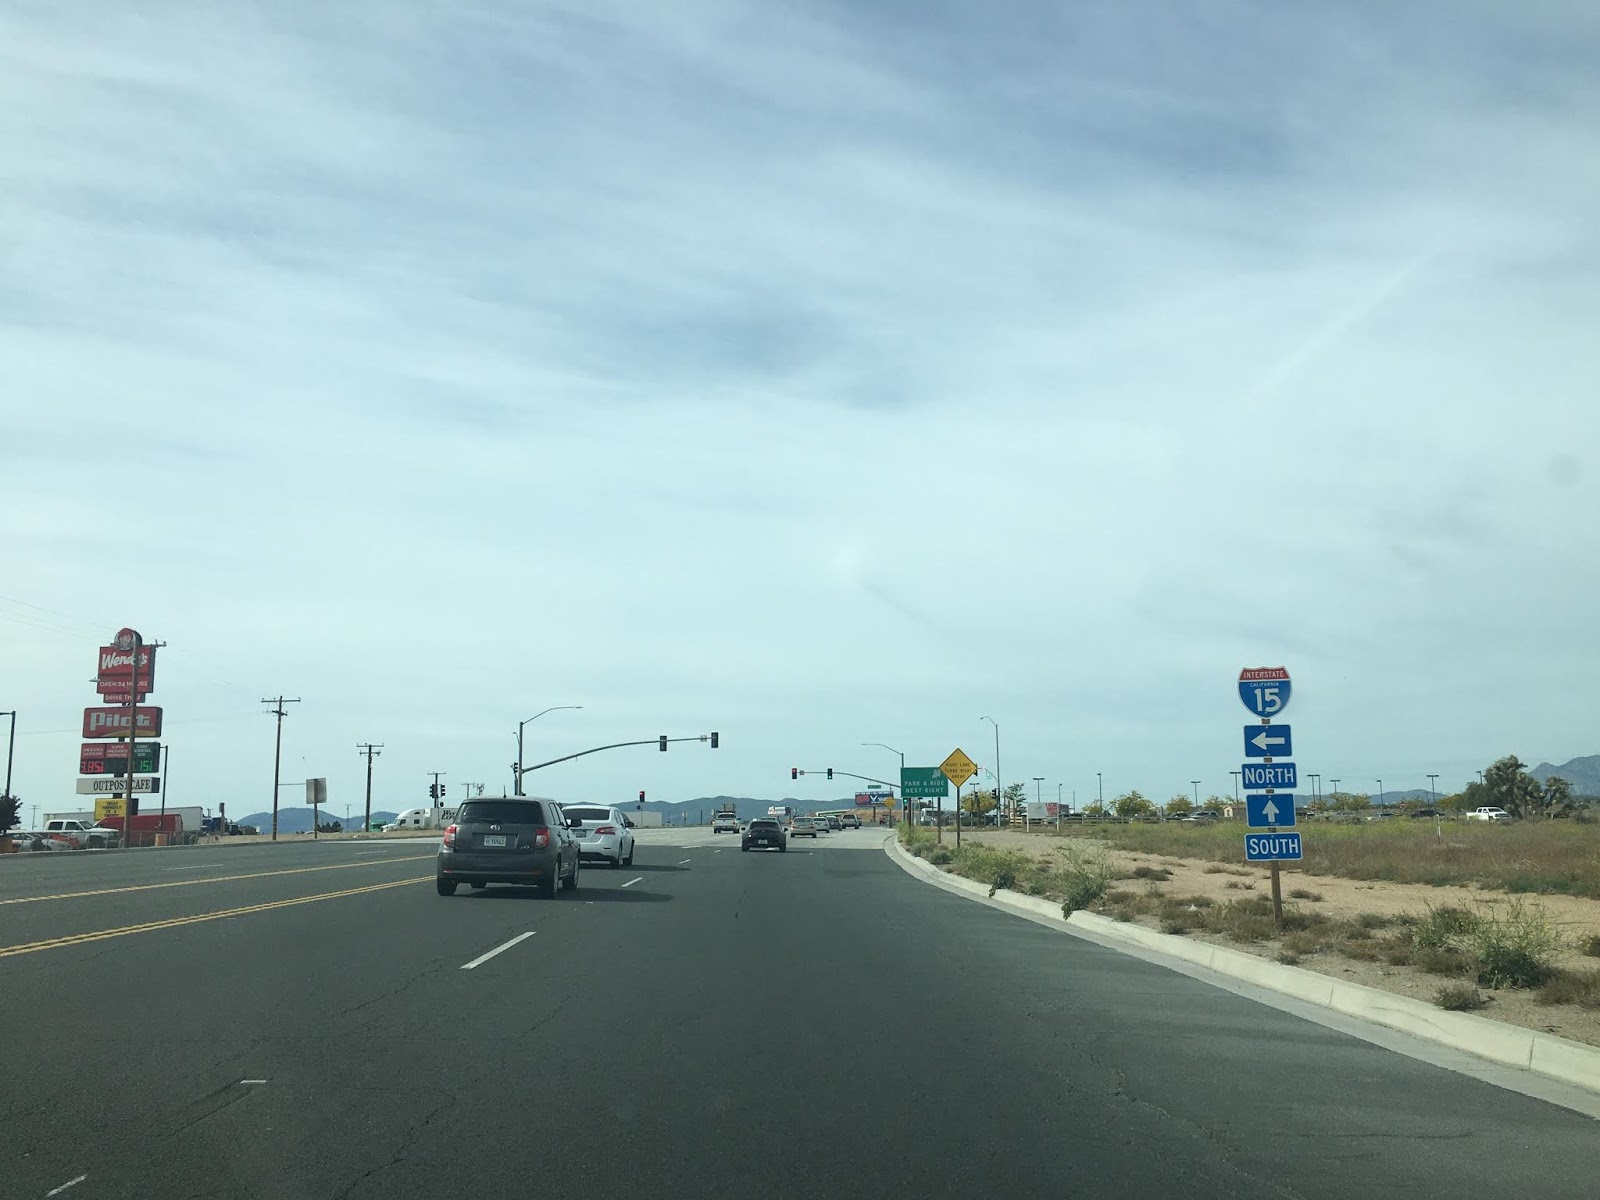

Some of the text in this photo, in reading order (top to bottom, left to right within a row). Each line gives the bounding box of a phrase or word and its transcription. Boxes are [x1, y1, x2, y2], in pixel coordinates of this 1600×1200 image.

[101, 652, 148, 670] Wend's
[1243, 670, 1284, 679] INTERSTATE
[1254, 688, 1282, 712] 15
[1245, 768, 1294, 784] NORTH
[93, 779, 151, 791] OUTPOST CAFE
[1249, 838, 1299, 855] SOUTH
